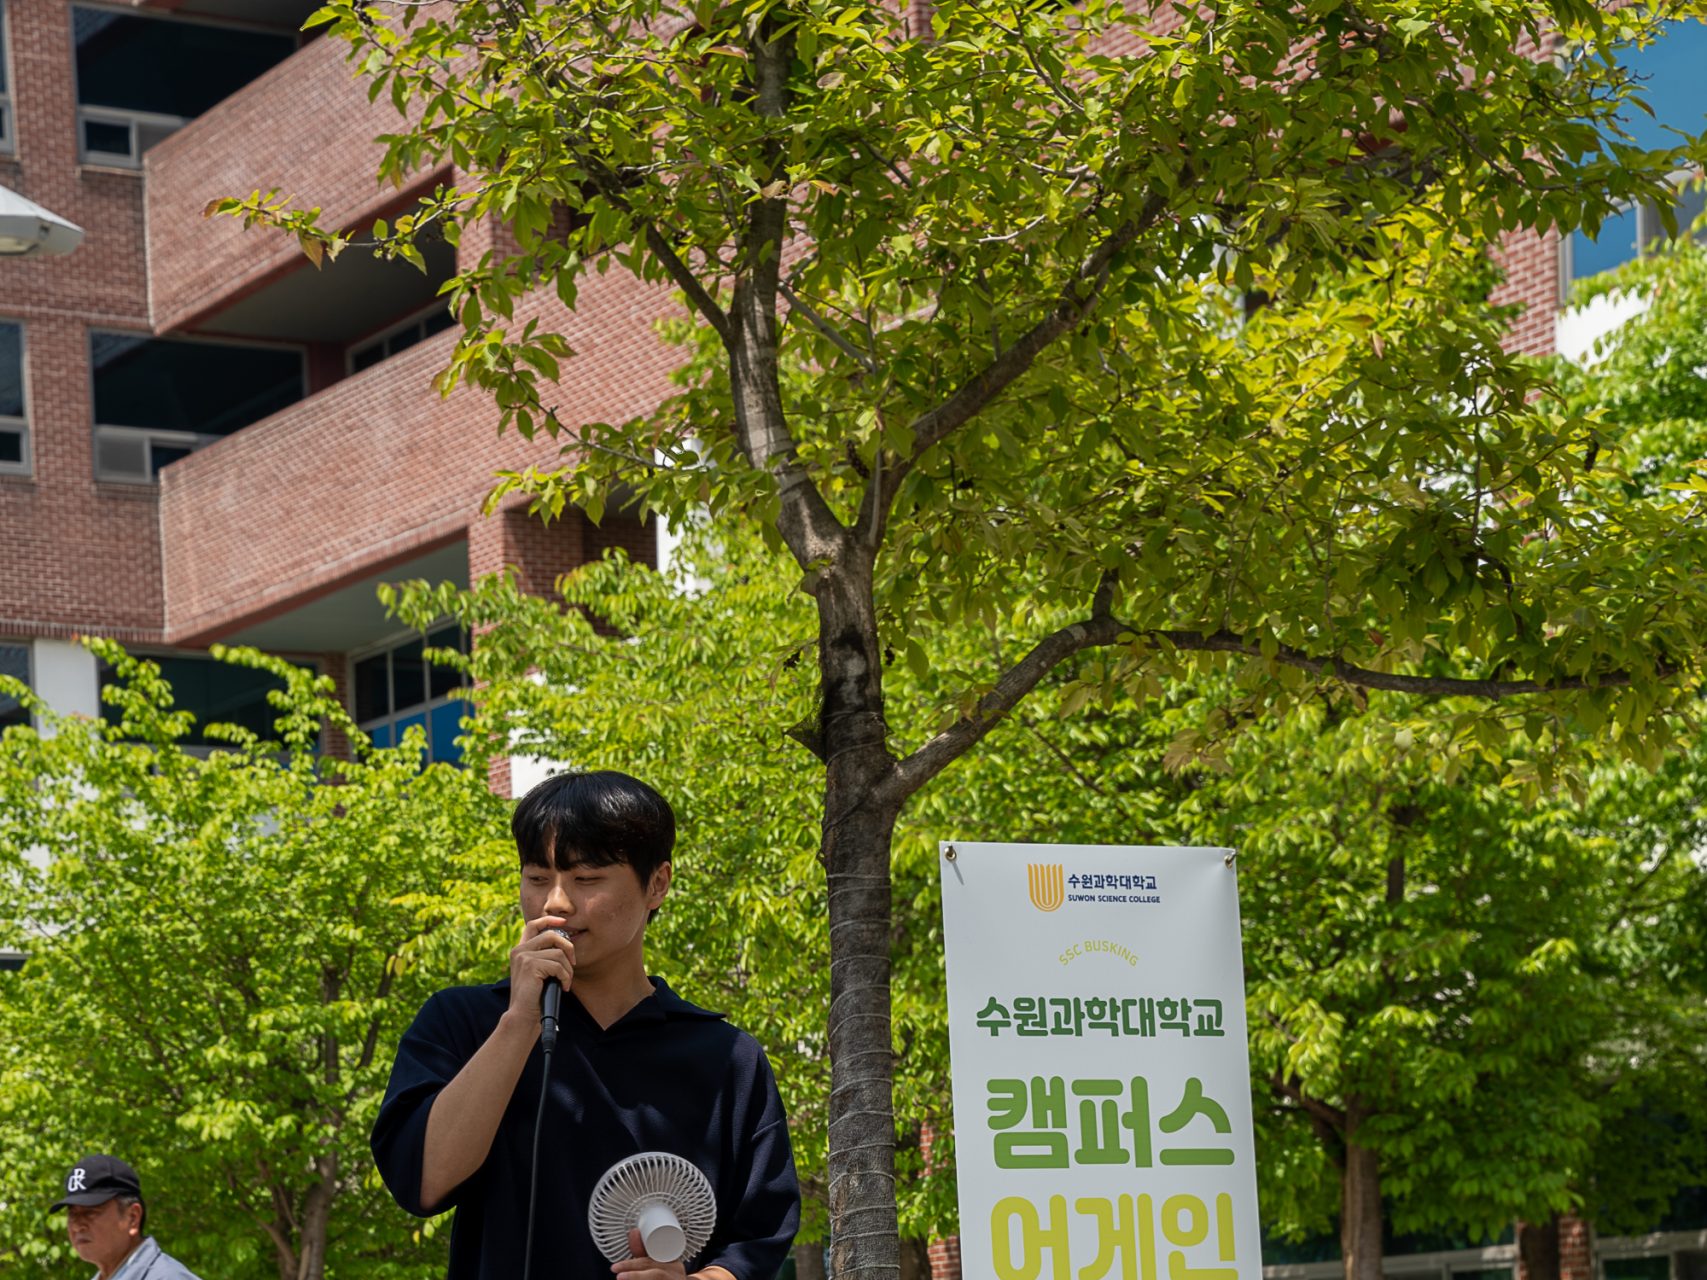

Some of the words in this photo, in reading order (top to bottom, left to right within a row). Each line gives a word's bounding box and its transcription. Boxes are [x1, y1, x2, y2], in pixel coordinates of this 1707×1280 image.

[1068, 874, 1157, 890] 수원과학대학교
[1068, 894, 1096, 902] SUWON
[1097, 895, 1127, 903] SCIENCE
[1129, 895, 1161, 904] COLLEGE
[1059, 943, 1082, 966] SSC
[1084, 940, 1139, 967] BUSKING
[976, 996, 1226, 1037] 수원과학대학교
[986, 1075, 1236, 1170] 캠퍼스
